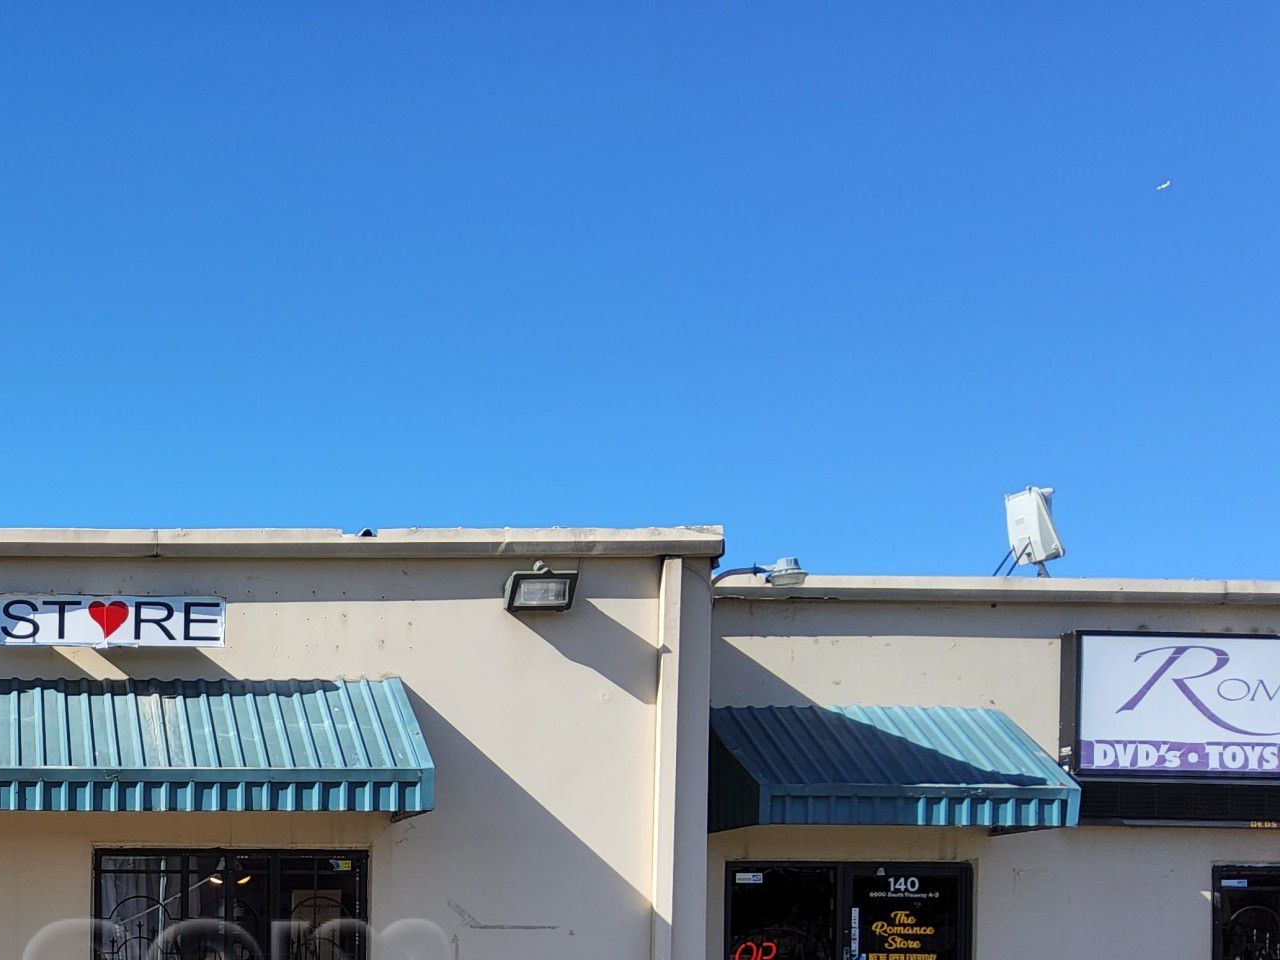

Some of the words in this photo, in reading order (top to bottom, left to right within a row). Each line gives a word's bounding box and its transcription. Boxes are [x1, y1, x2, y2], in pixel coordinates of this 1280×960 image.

[1093, 742, 1181, 769] DVD's
[1205, 744, 1280, 770] TOYS
[888, 876, 920, 892] 140
[890, 910, 917, 924] The
[871, 921, 935, 937] Romance
[884, 935, 922, 950] Store
